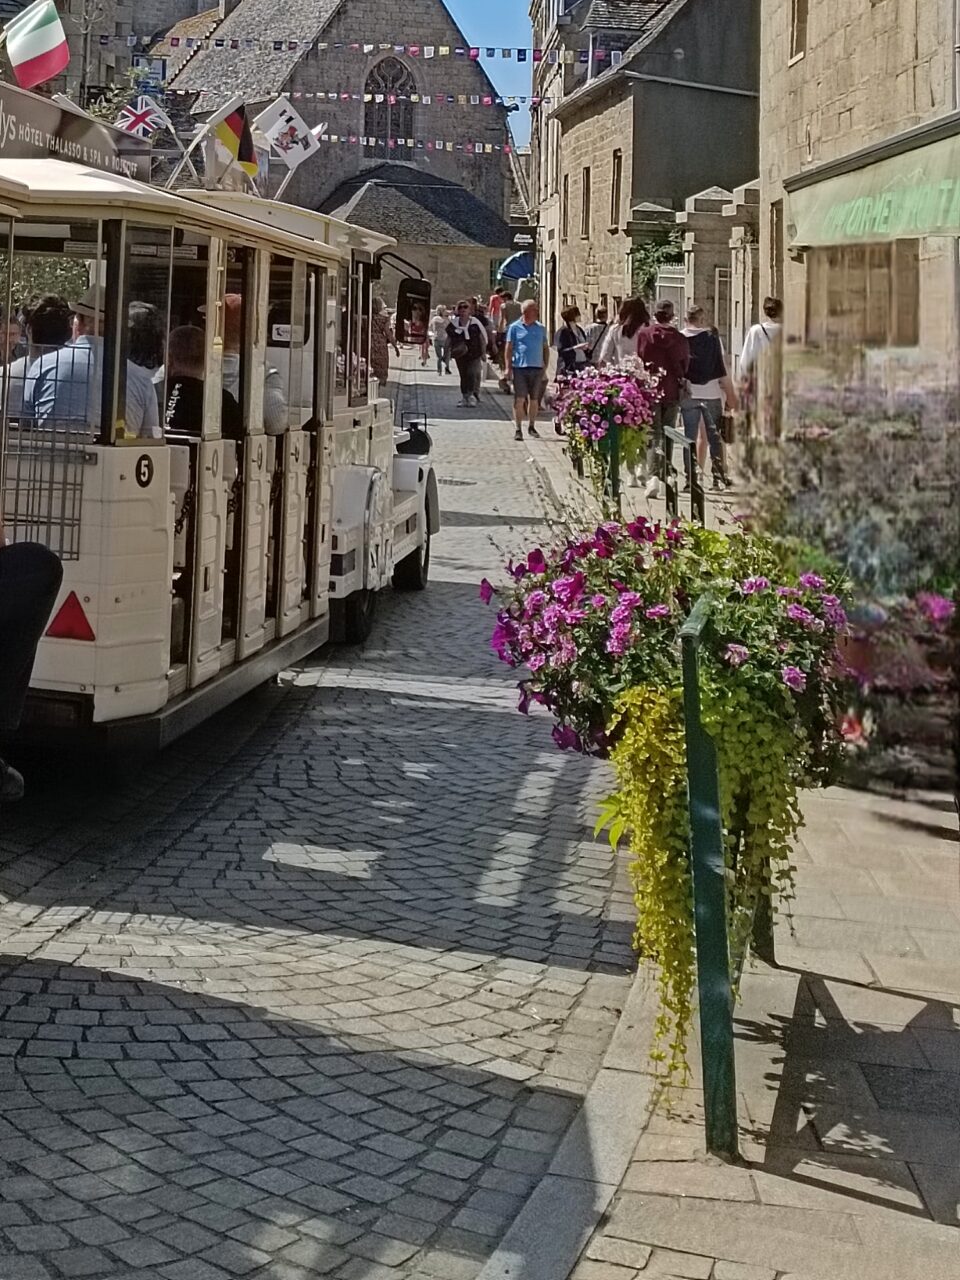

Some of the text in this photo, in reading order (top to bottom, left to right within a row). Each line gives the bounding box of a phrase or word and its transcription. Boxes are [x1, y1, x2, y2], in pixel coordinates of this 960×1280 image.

[18, 123, 43, 147] HÔTEL
[45, 133, 81, 159] THALASSO
[83, 146, 88, 161] &
[90, 148, 101, 166] SPA
[140, 460, 149, 482] 5
